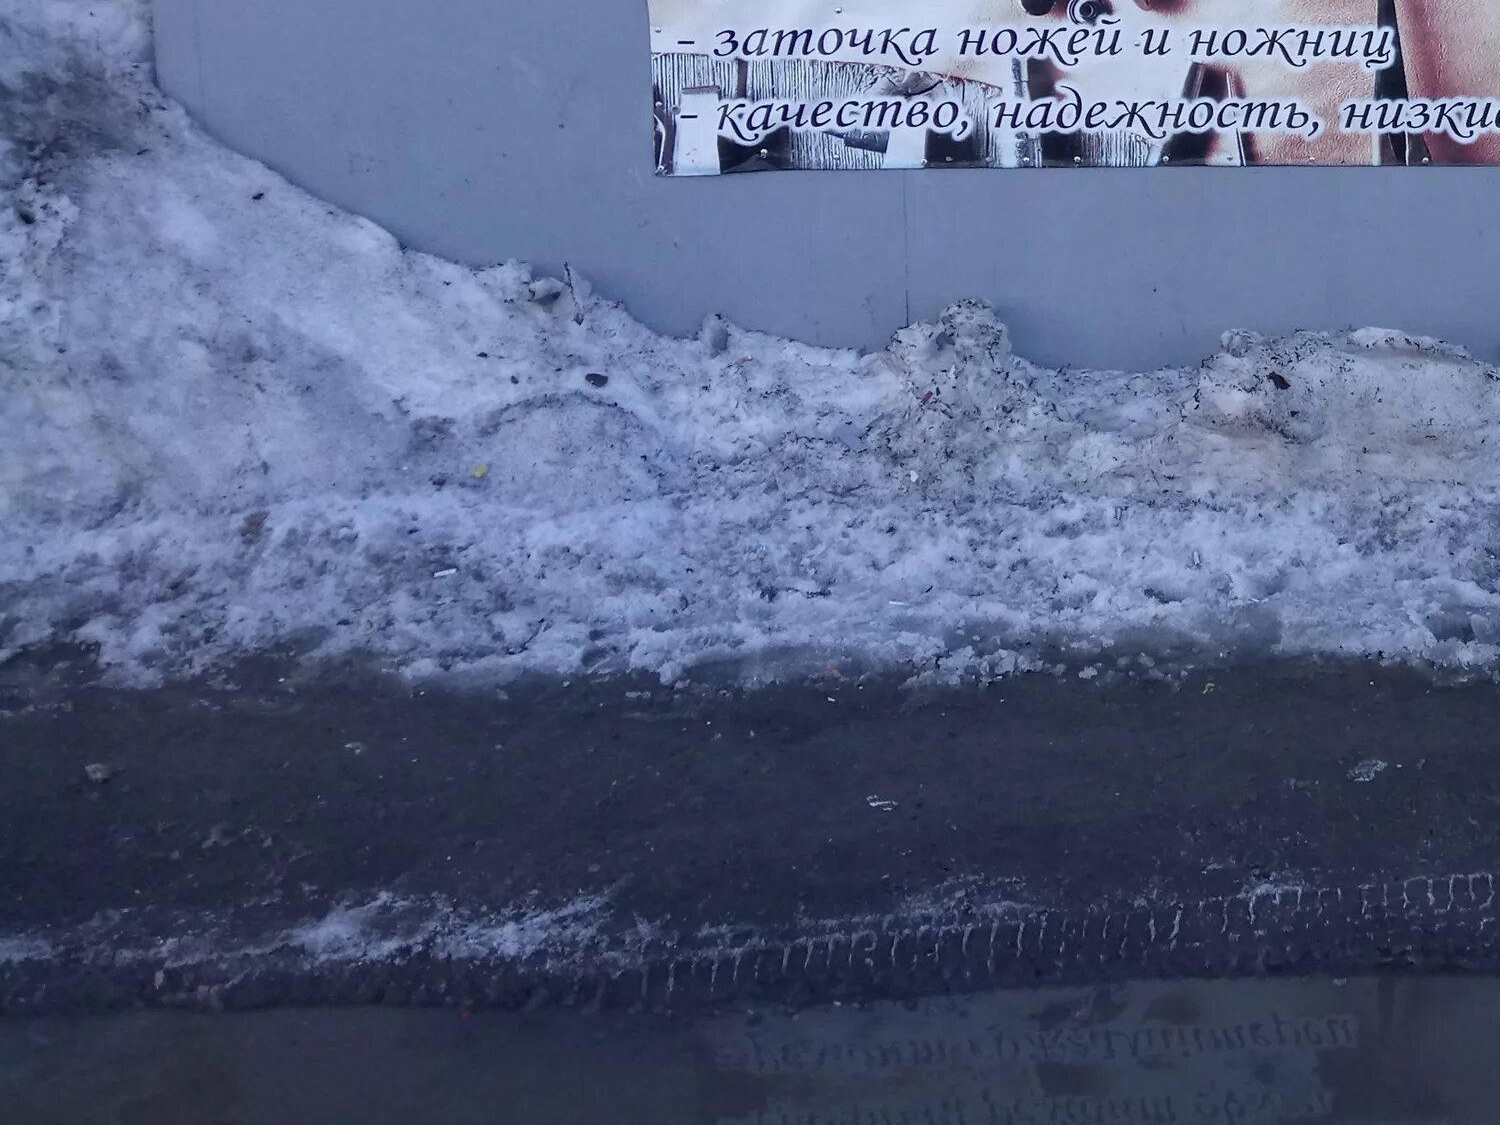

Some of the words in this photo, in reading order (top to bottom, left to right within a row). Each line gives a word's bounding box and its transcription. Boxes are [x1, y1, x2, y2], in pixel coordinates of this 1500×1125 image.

[714, 27, 938, 66] заточка
[958, 19, 1123, 67] ножей
[1141, 28, 1171, 56] и
[1190, 27, 1392, 68] ножниц
[718, 100, 969, 139] качество,
[994, 86, 1321, 137] надежность,
